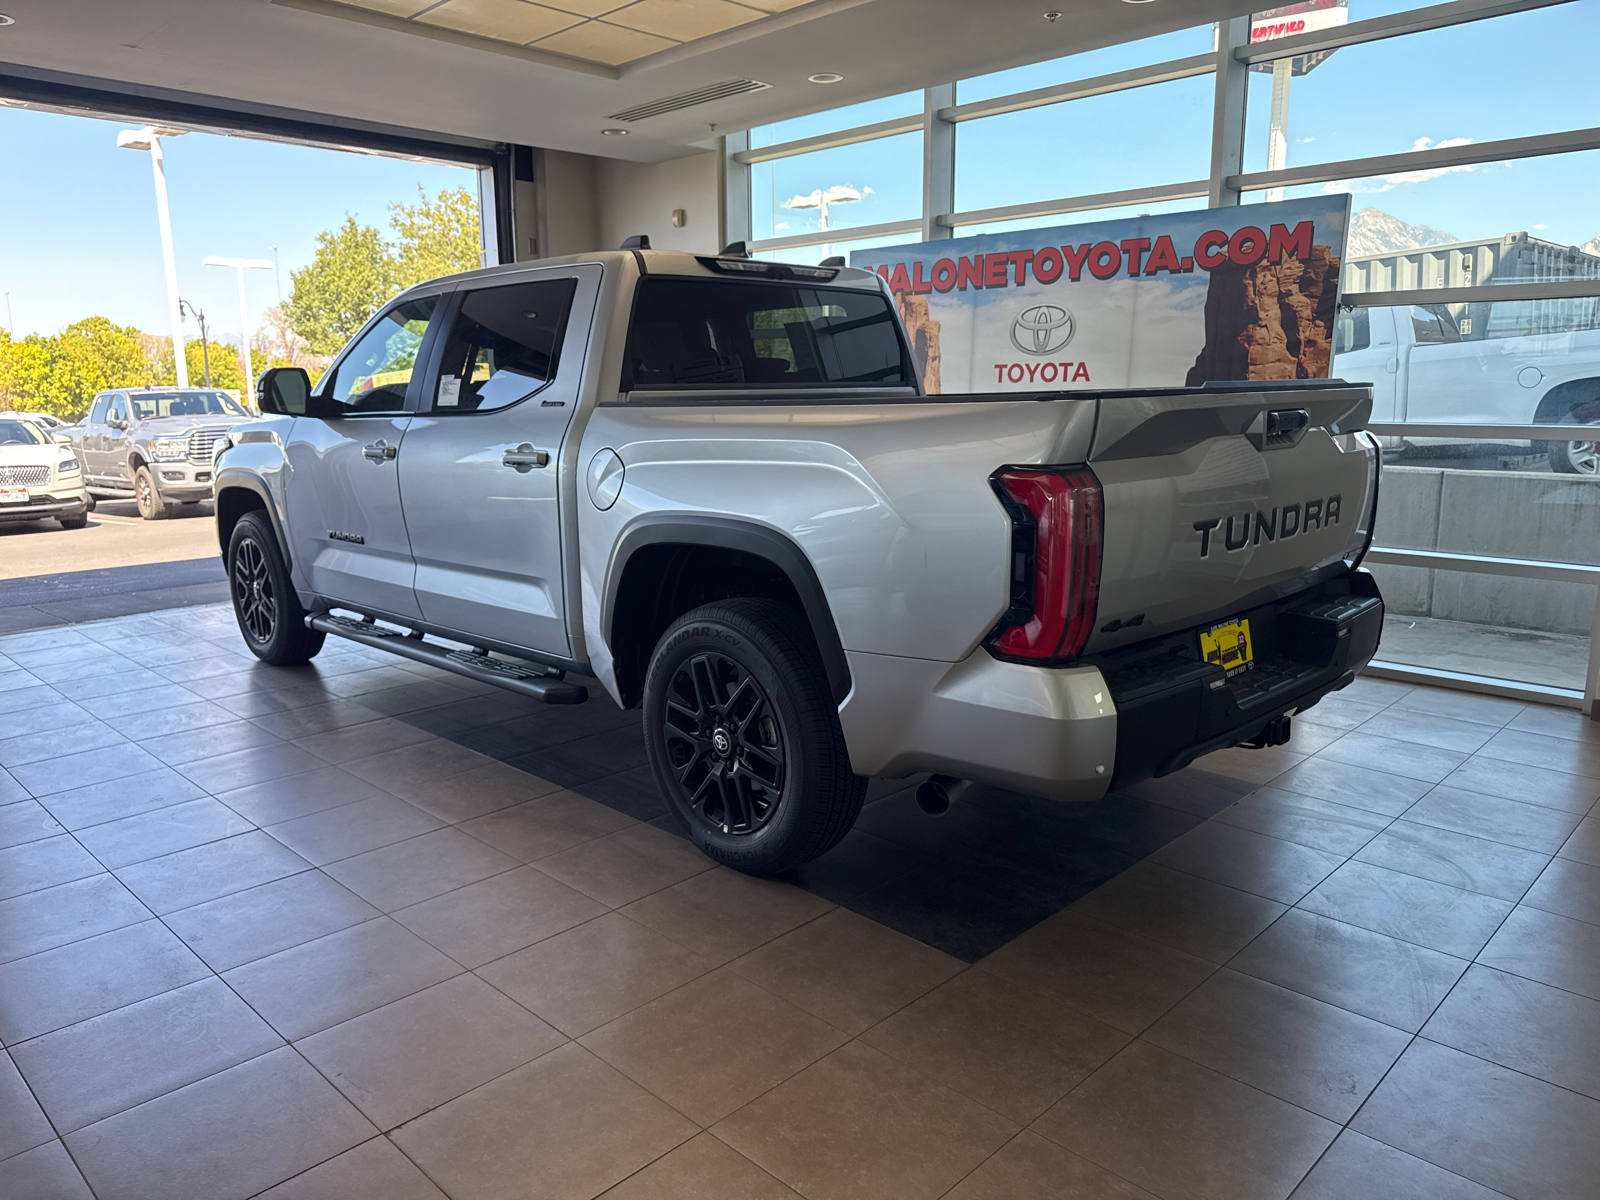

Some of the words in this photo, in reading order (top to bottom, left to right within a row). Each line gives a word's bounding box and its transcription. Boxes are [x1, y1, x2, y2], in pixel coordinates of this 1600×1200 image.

[994, 362, 1090, 383] TOYOTA
[327, 530, 365, 545] TUNDRA
[1193, 494, 1342, 560] TUNDRA
[648, 626, 711, 692] GEOLANDAR
[704, 840, 760, 862] YOKOHAMA
